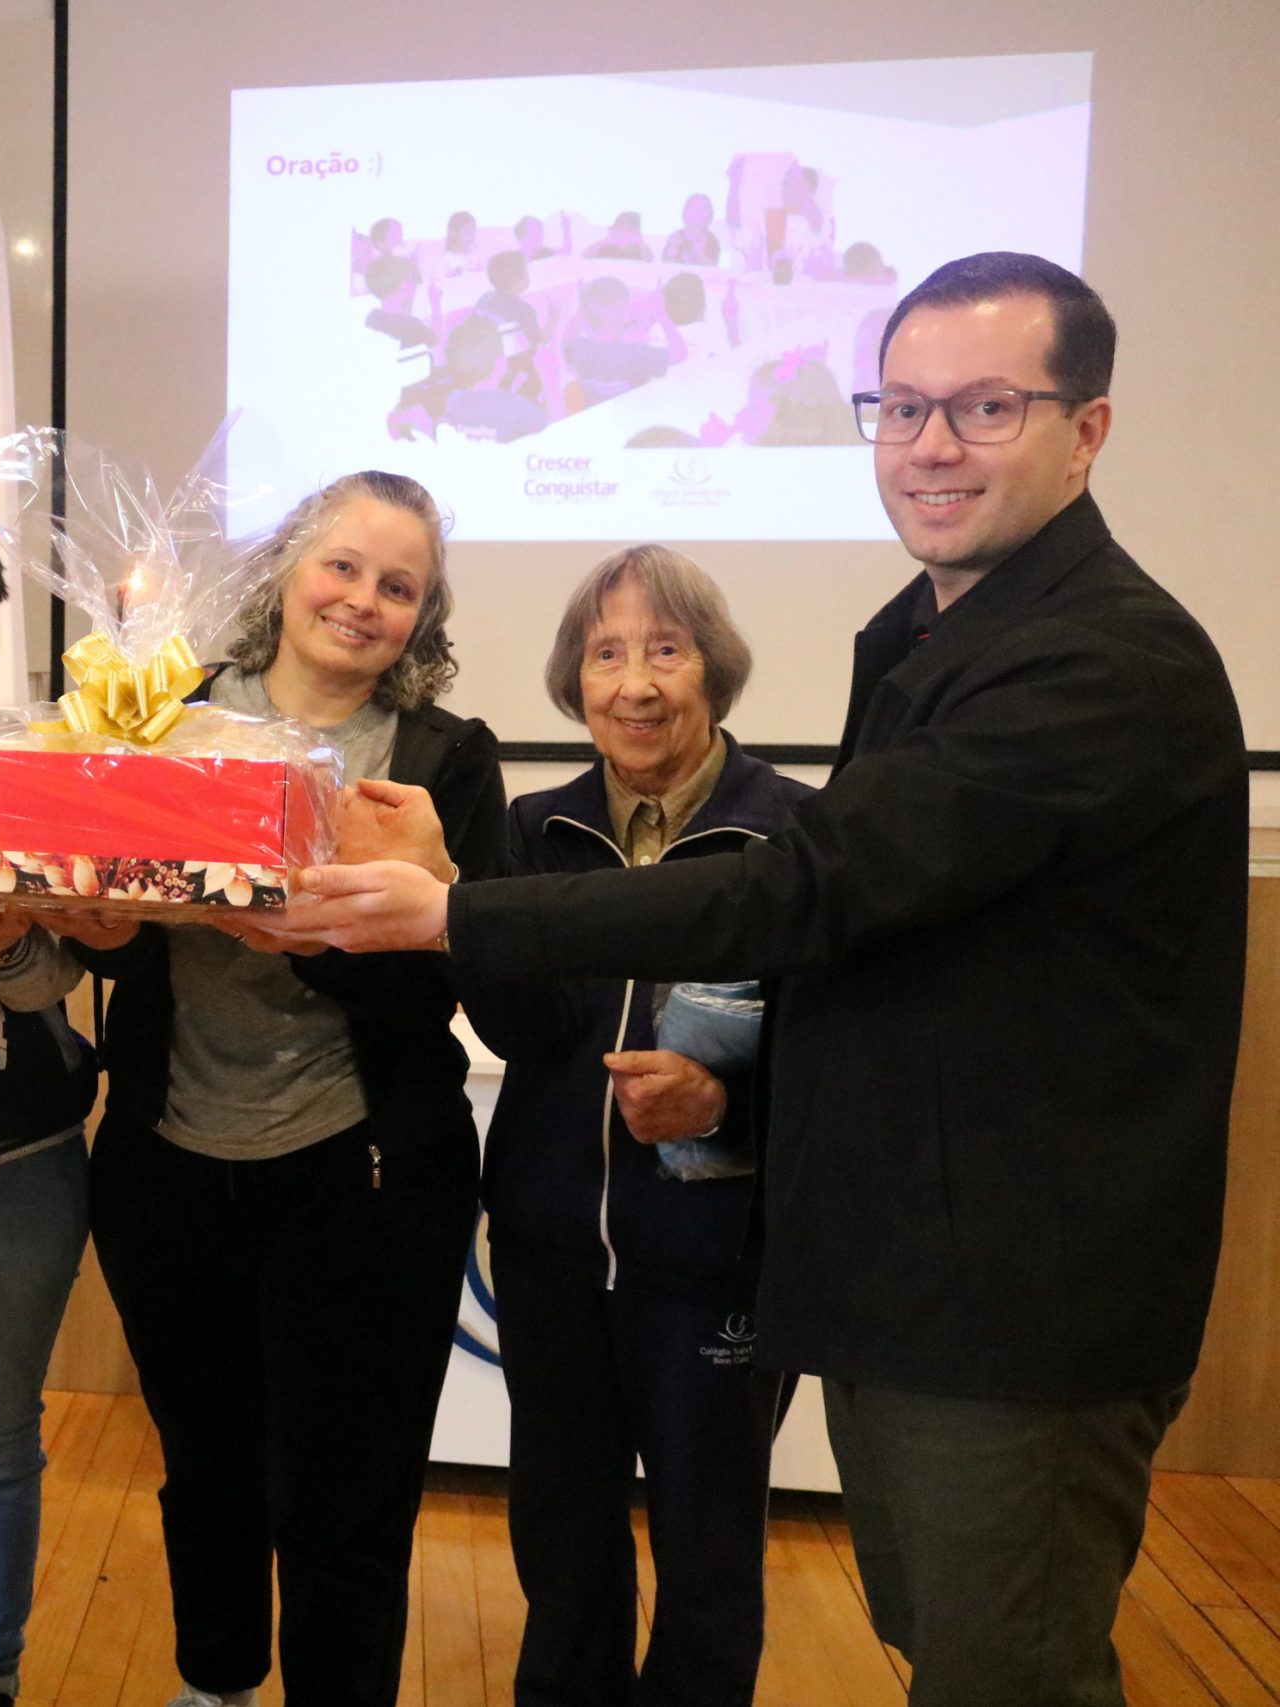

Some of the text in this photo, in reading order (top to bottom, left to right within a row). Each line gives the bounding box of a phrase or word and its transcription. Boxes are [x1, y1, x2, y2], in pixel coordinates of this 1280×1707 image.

[266, 151, 359, 180] Oração
[526, 454, 592, 471] Crescer
[524, 479, 619, 499] Conquistar
